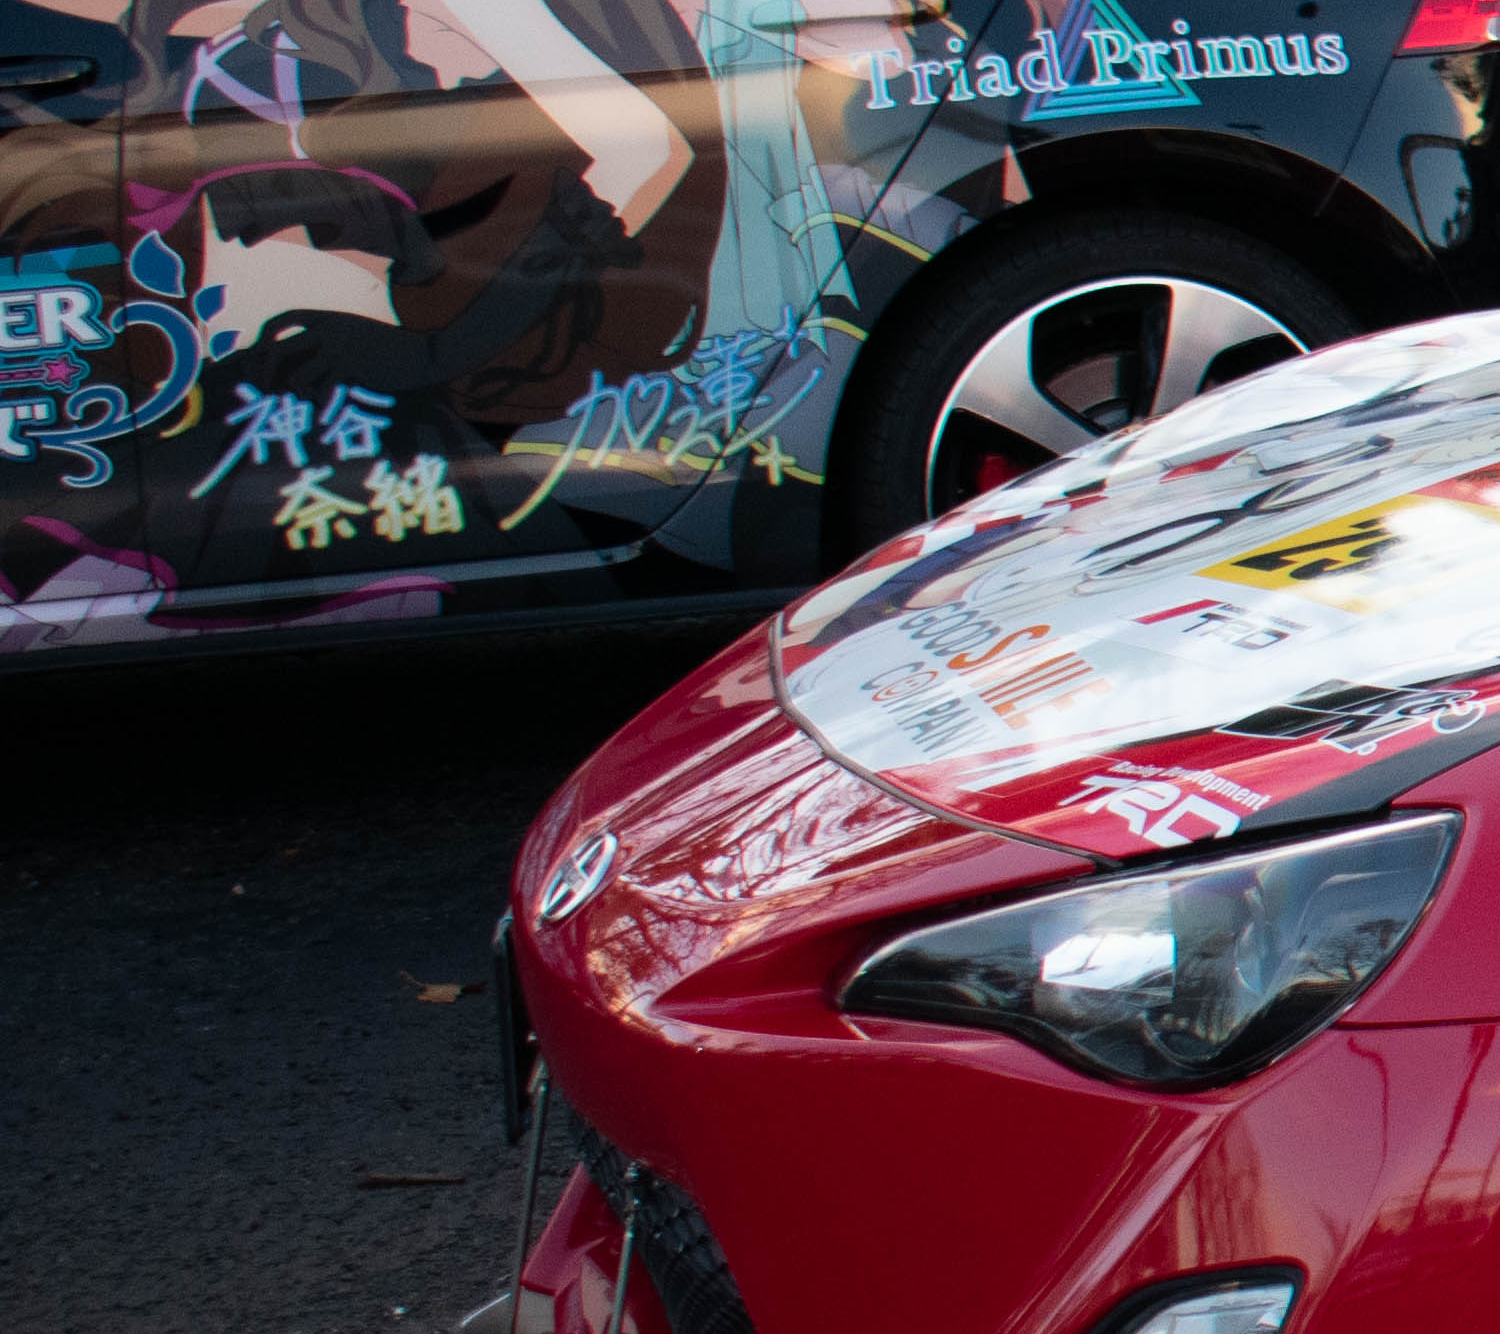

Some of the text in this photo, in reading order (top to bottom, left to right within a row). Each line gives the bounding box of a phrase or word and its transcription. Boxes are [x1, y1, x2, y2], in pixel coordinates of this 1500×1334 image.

[851, 19, 1349, 110] Triad Primus
[190, 381, 396, 499] 神谷
[273, 454, 467, 549] 奈緒
[1058, 775, 1242, 848] TRD
